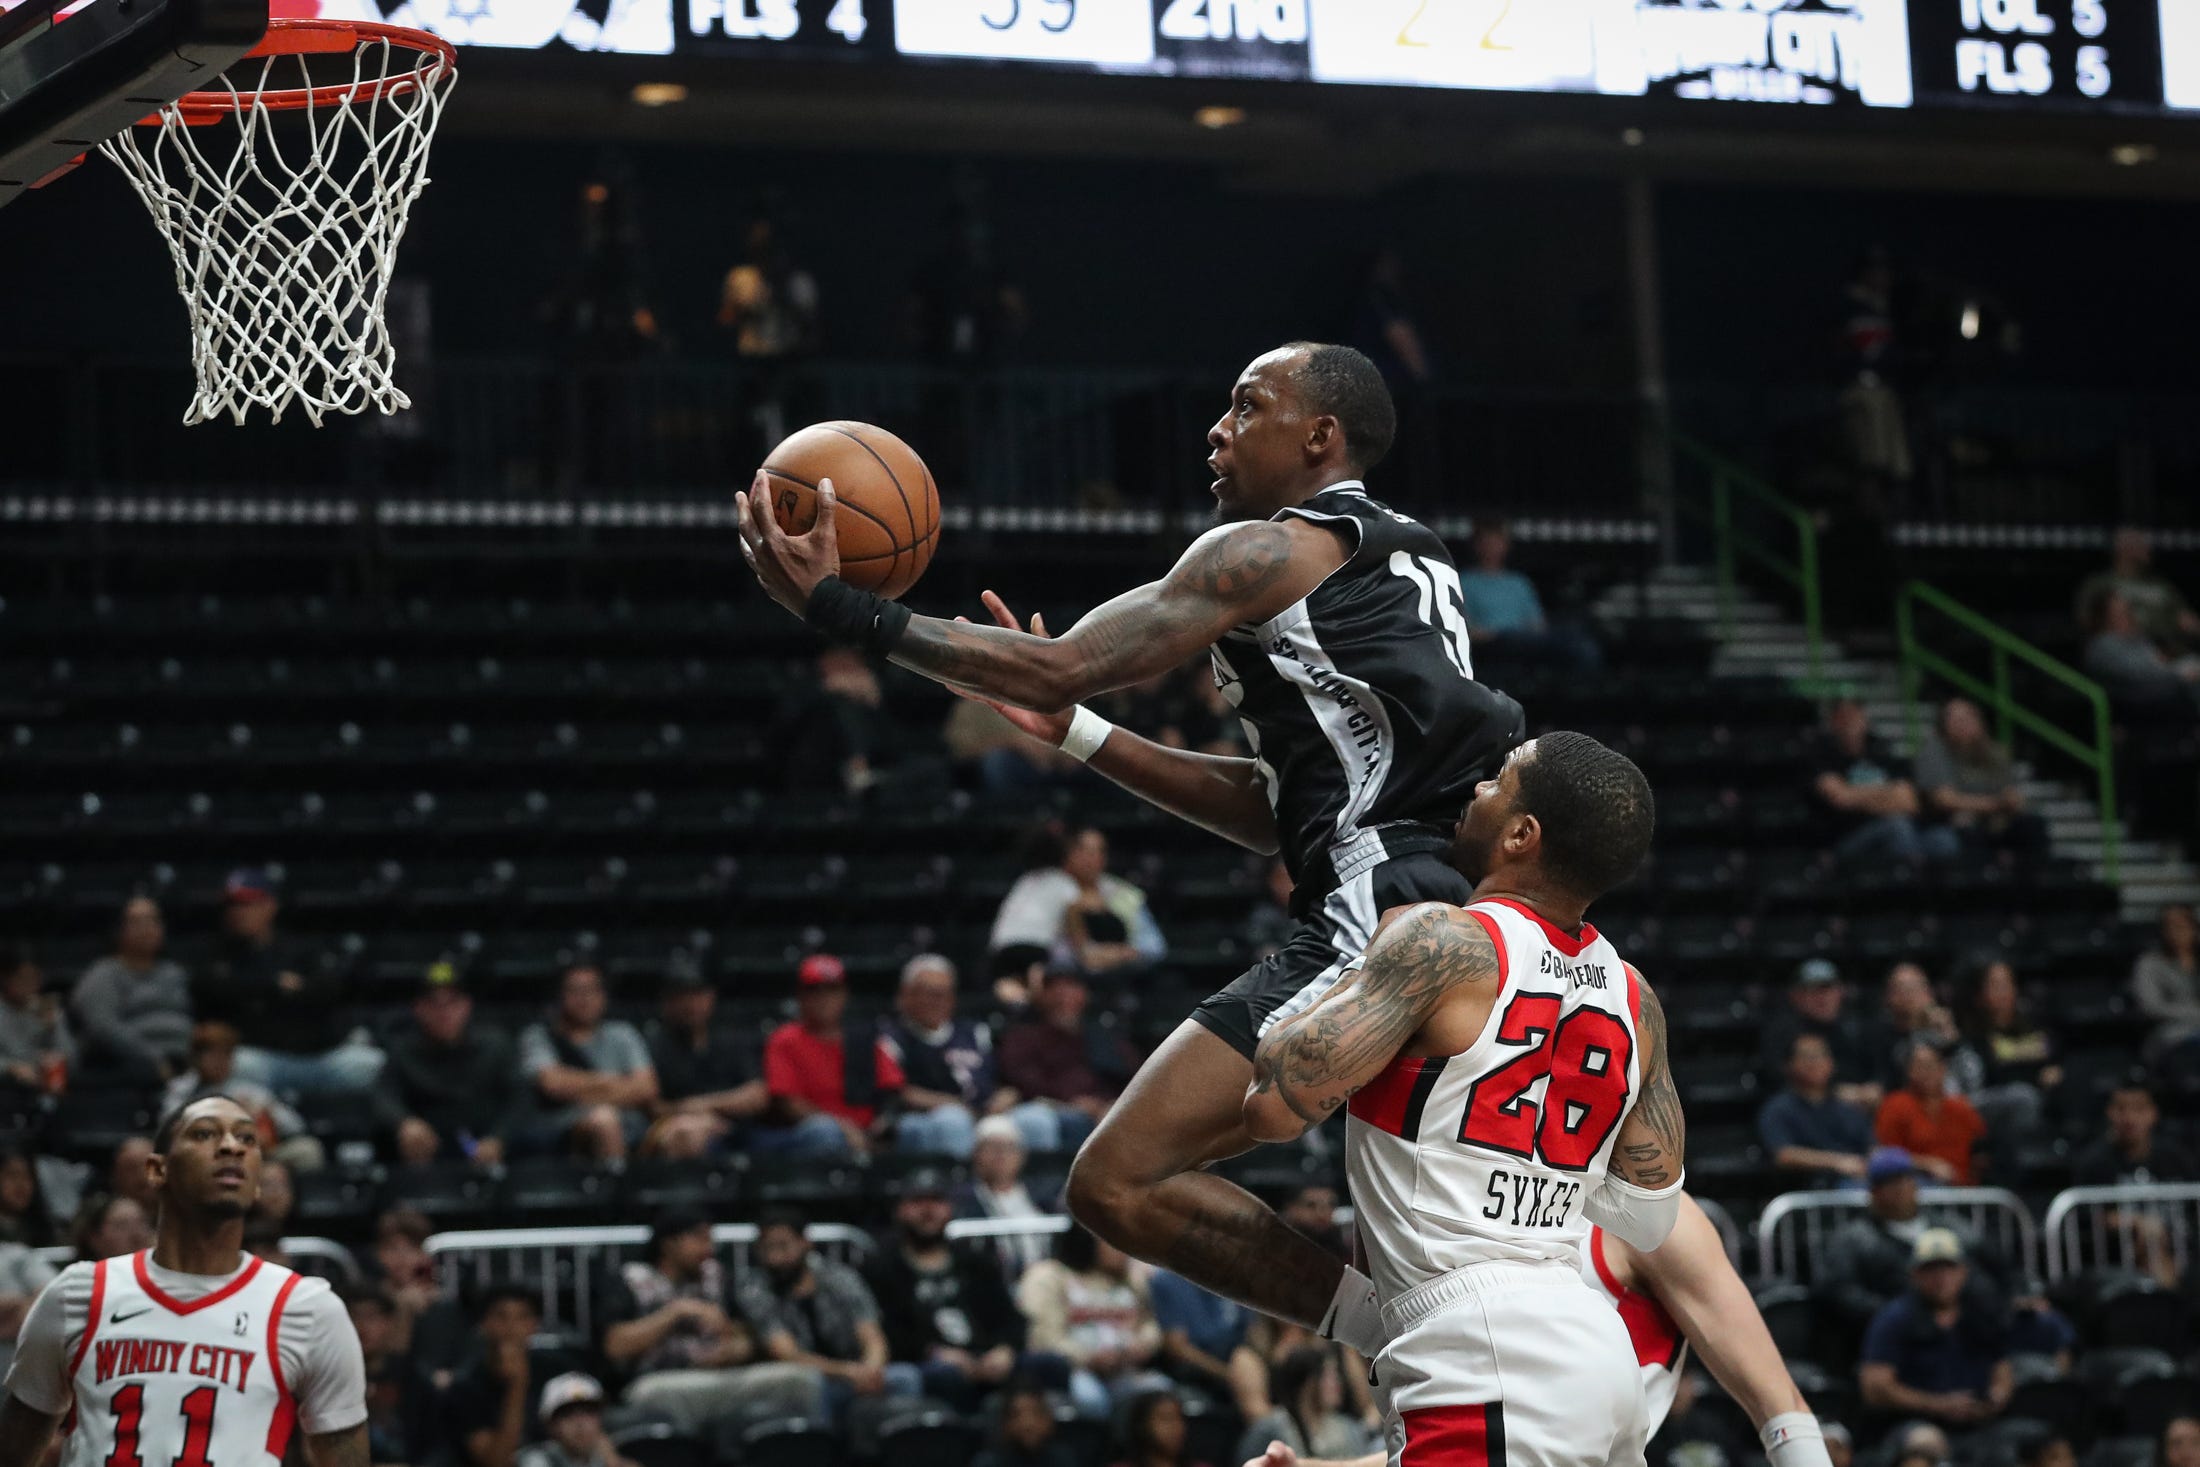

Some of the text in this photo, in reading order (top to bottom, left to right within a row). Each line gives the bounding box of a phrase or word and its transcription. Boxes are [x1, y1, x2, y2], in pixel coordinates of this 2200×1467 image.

[689, 0, 868, 44] FLS 4
[1159, 0, 1307, 43] 2nd
[1956, 38, 2112, 98] FLS 5
[1456, 989, 1633, 1172] 28
[1483, 1169, 1580, 1228] SYKES
[96, 1338, 256, 1393] WINDY CITY
[104, 1383, 219, 1467] 11
